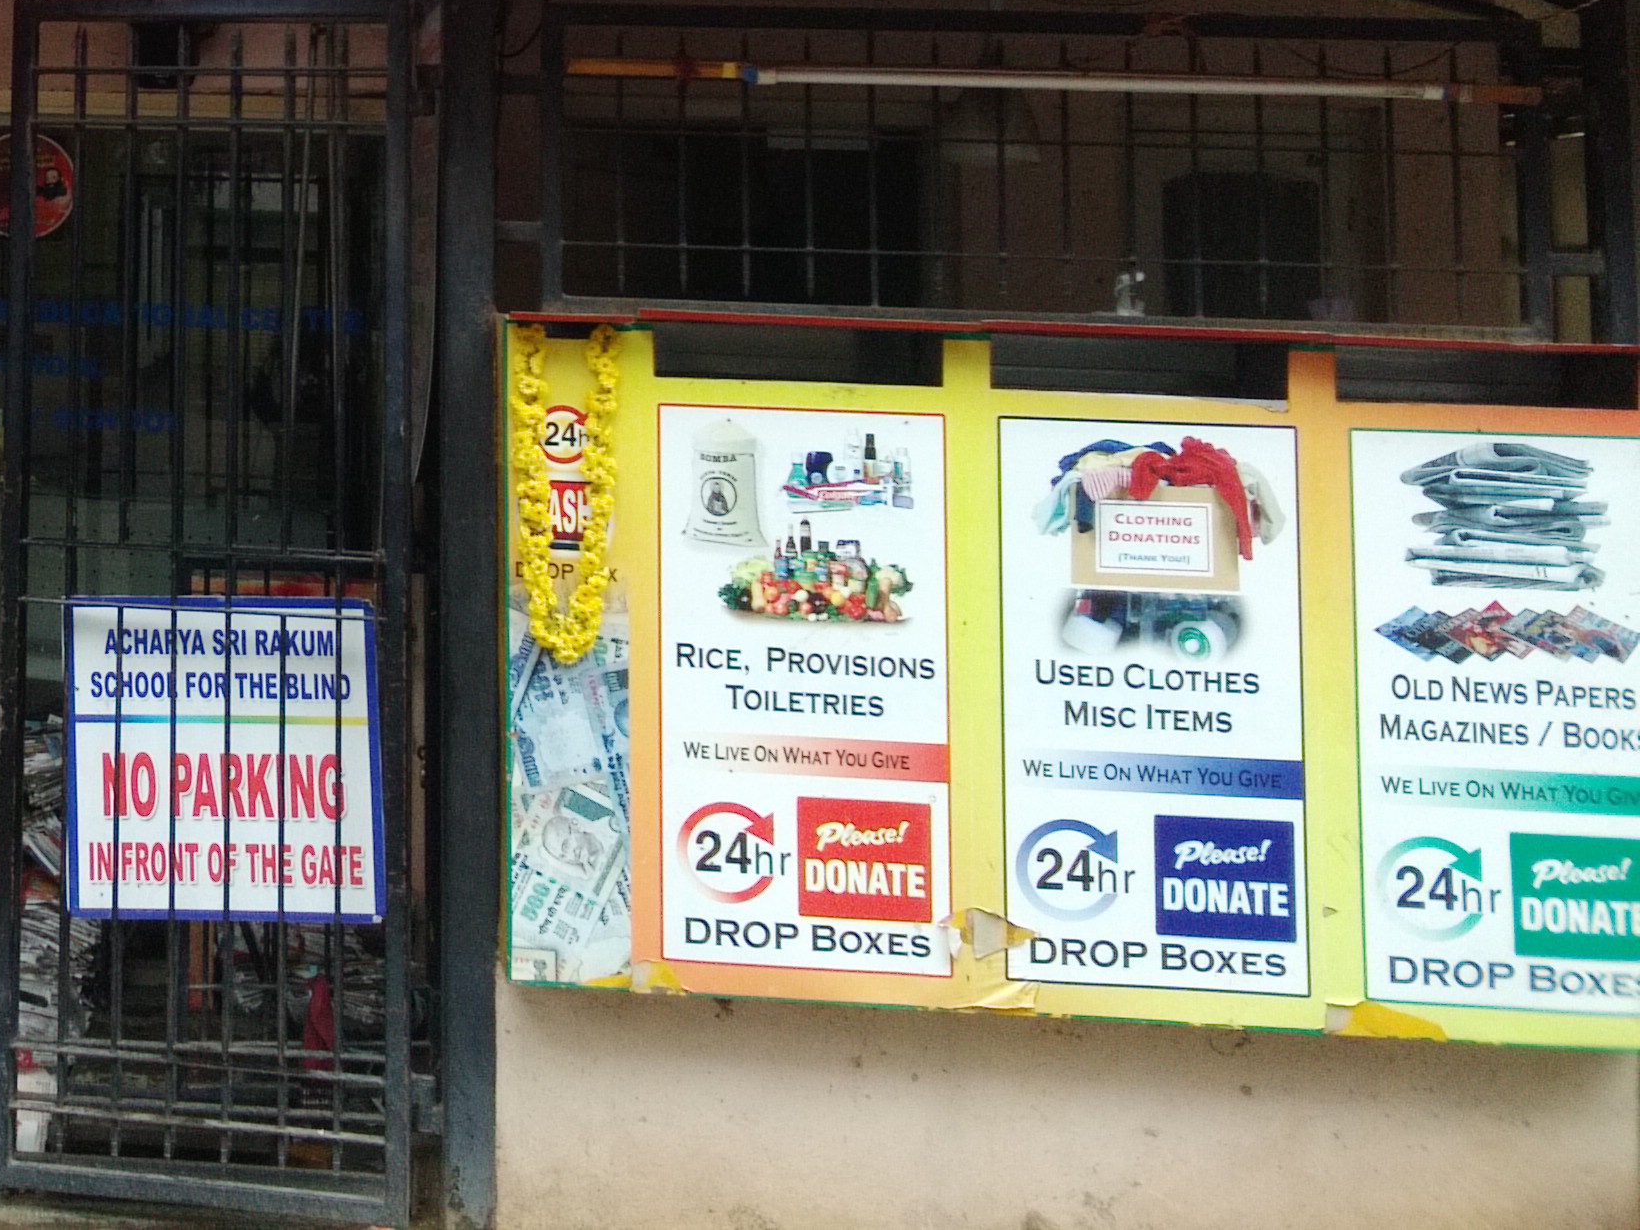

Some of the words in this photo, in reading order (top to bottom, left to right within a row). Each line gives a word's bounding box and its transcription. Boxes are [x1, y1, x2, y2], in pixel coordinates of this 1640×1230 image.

[1108, 530, 1200, 545] DONATIONS
[1114, 513, 1193, 527] CLOTHING
[213, 629, 247, 656] SRI
[256, 630, 334, 656] RAKUM
[676, 643, 750, 675] RICE,
[767, 647, 935, 679] PROVISIONS
[1035, 659, 1114, 687] USED
[1124, 664, 1260, 694] CLOTHES
[235, 673, 278, 699] THE
[725, 684, 884, 717] TOILETRIES
[1392, 674, 1444, 700] OLD
[1452, 676, 1528, 705] NEWS
[1536, 680, 1636, 710] PAPERS
[1064, 700, 1136, 728] MISC
[1147, 705, 1233, 733] ITEMS
[1380, 714, 1529, 746] MAGAZINES
[1563, 722, 1640, 751] BOOK
[683, 741, 710, 759] WE
[715, 743, 750, 761] LIVE
[754, 745, 777, 763] ON
[783, 747, 832, 765] WHAT
[836, 750, 868, 767] YOU
[871, 751, 910, 770] GIVE
[102, 752, 156, 817] NO
[173, 753, 345, 820] PARKING
[1023, 759, 1053, 777] WE
[1059, 761, 1098, 780] LIVE
[1104, 763, 1131, 782] ON
[1137, 765, 1192, 784] WHAT
[1197, 768, 1232, 786] YOU
[1239, 770, 1282, 789] GIVE
[1381, 776, 1413, 794] WE
[1419, 778, 1460, 797] LIVE
[1466, 780, 1494, 798] ON
[1500, 782, 1559, 802] WHAT
[1563, 785, 1601, 804] YOU
[1608, 787, 1640, 806] GIV
[695, 830, 791, 875] 24hr
[816, 821, 910, 851] Please!
[89, 842, 112, 881] IN
[121, 842, 199, 882] FRONT
[208, 843, 237, 882] OF
[245, 844, 293, 883] THE
[301, 845, 363, 885] GATE
[1036, 848, 1135, 893] 24hr
[1174, 839, 1272, 870] Please!
[804, 858, 926, 898] DONATE
[1396, 865, 1502, 913] 24hr
[1532, 857, 1632, 890] Please!
[1163, 877, 1290, 917] DONATE
[685, 917, 799, 949] DROP
[812, 925, 931, 957] BOXES
[1030, 937, 1147, 968] DROP
[1161, 943, 1287, 977] BOXES
[1389, 956, 1515, 989] DROP
[1529, 964, 1640, 996] BOXE
